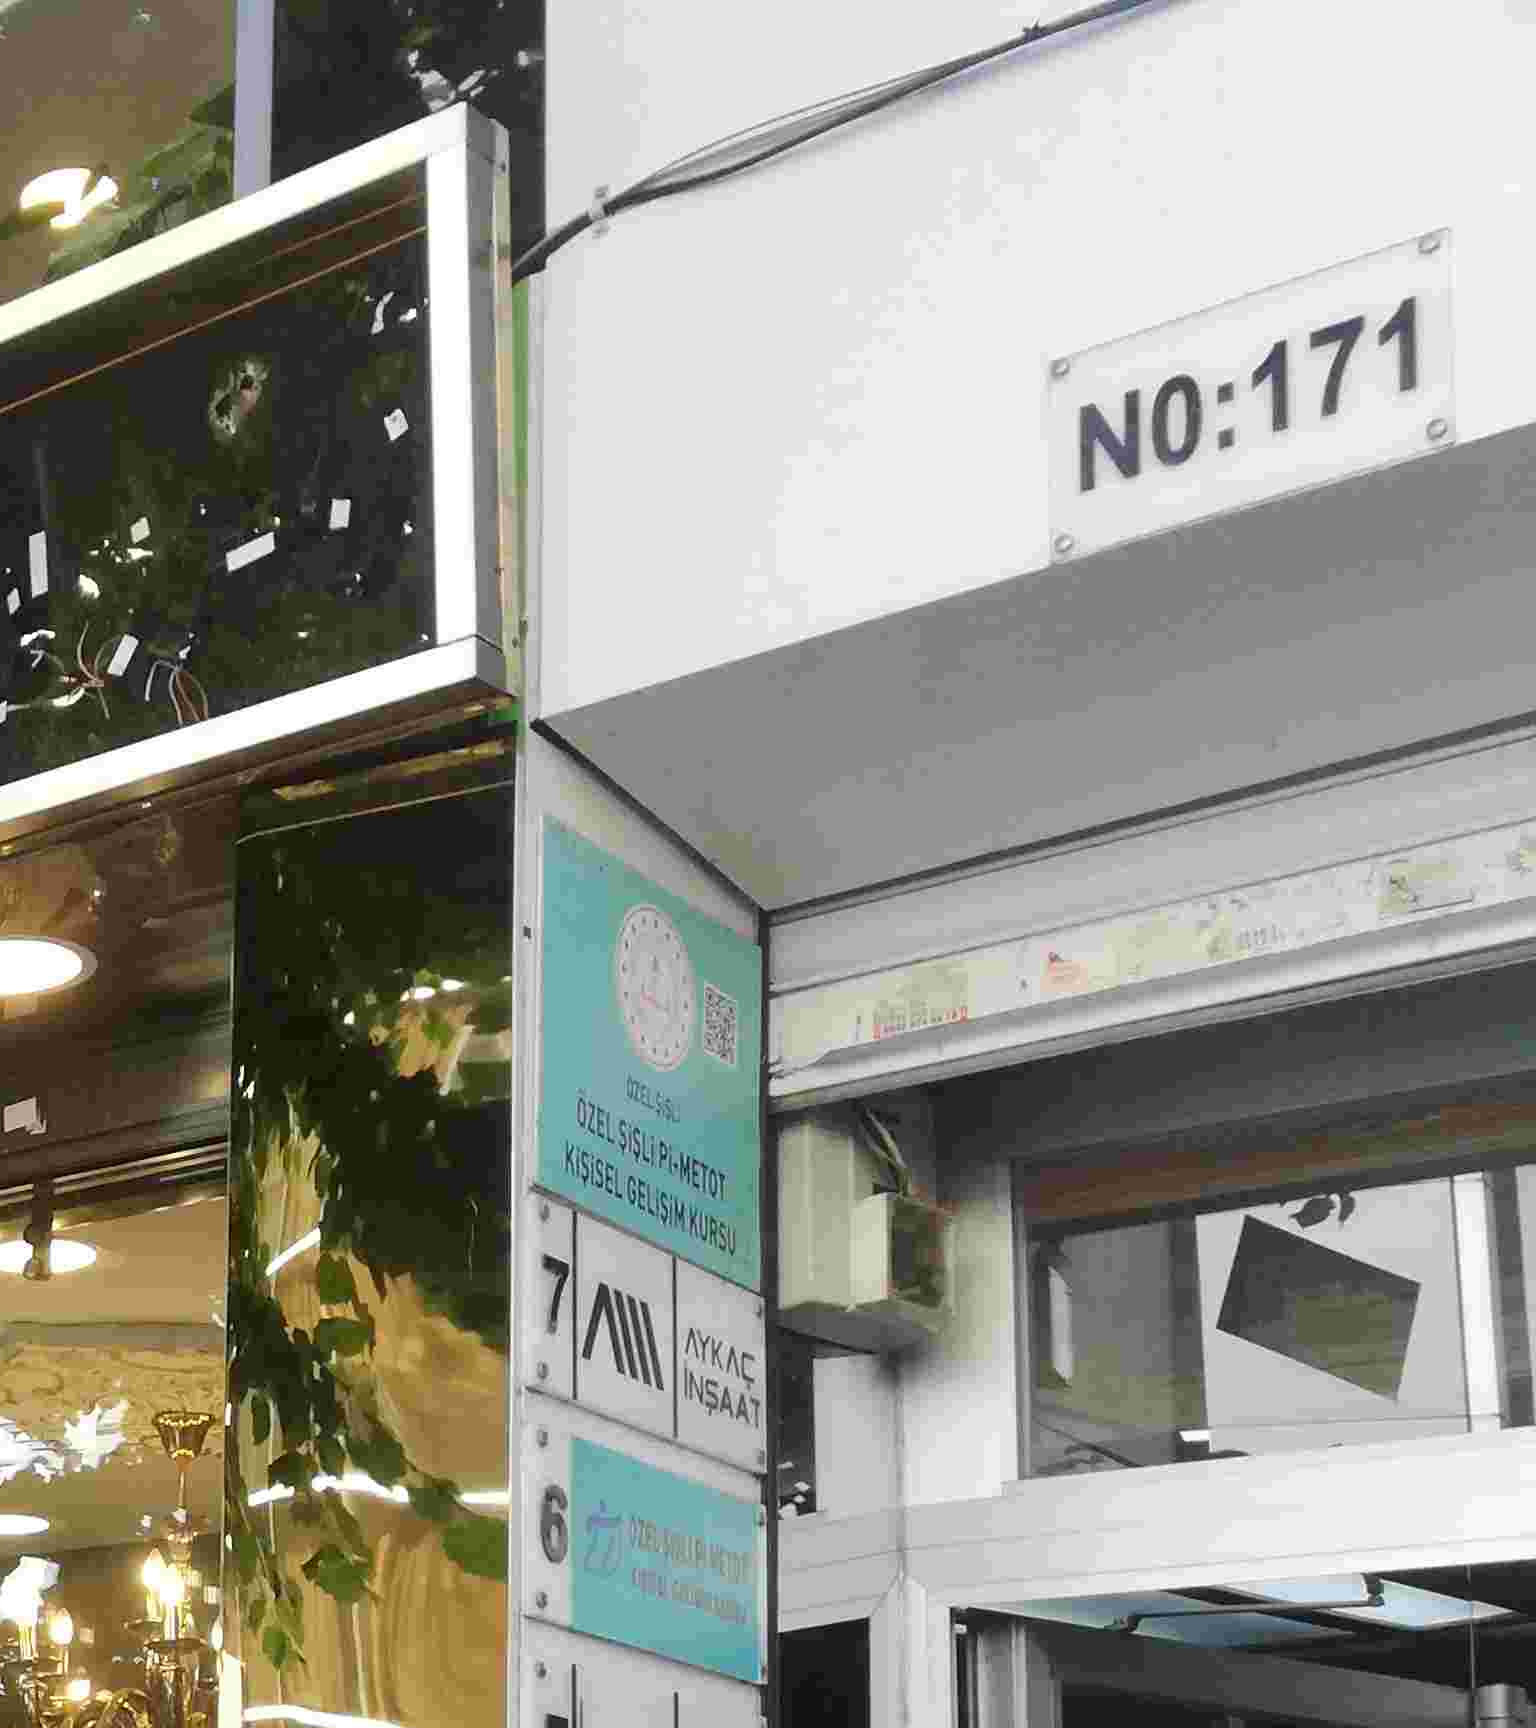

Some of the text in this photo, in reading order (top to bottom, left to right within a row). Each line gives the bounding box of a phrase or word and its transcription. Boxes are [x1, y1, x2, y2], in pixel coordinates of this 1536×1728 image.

[576, 1088, 615, 1145] ÖZEL
[688, 1206, 737, 1257] KURSU
[541, 1253, 570, 1335] 7
[540, 1484, 569, 1564] 6
